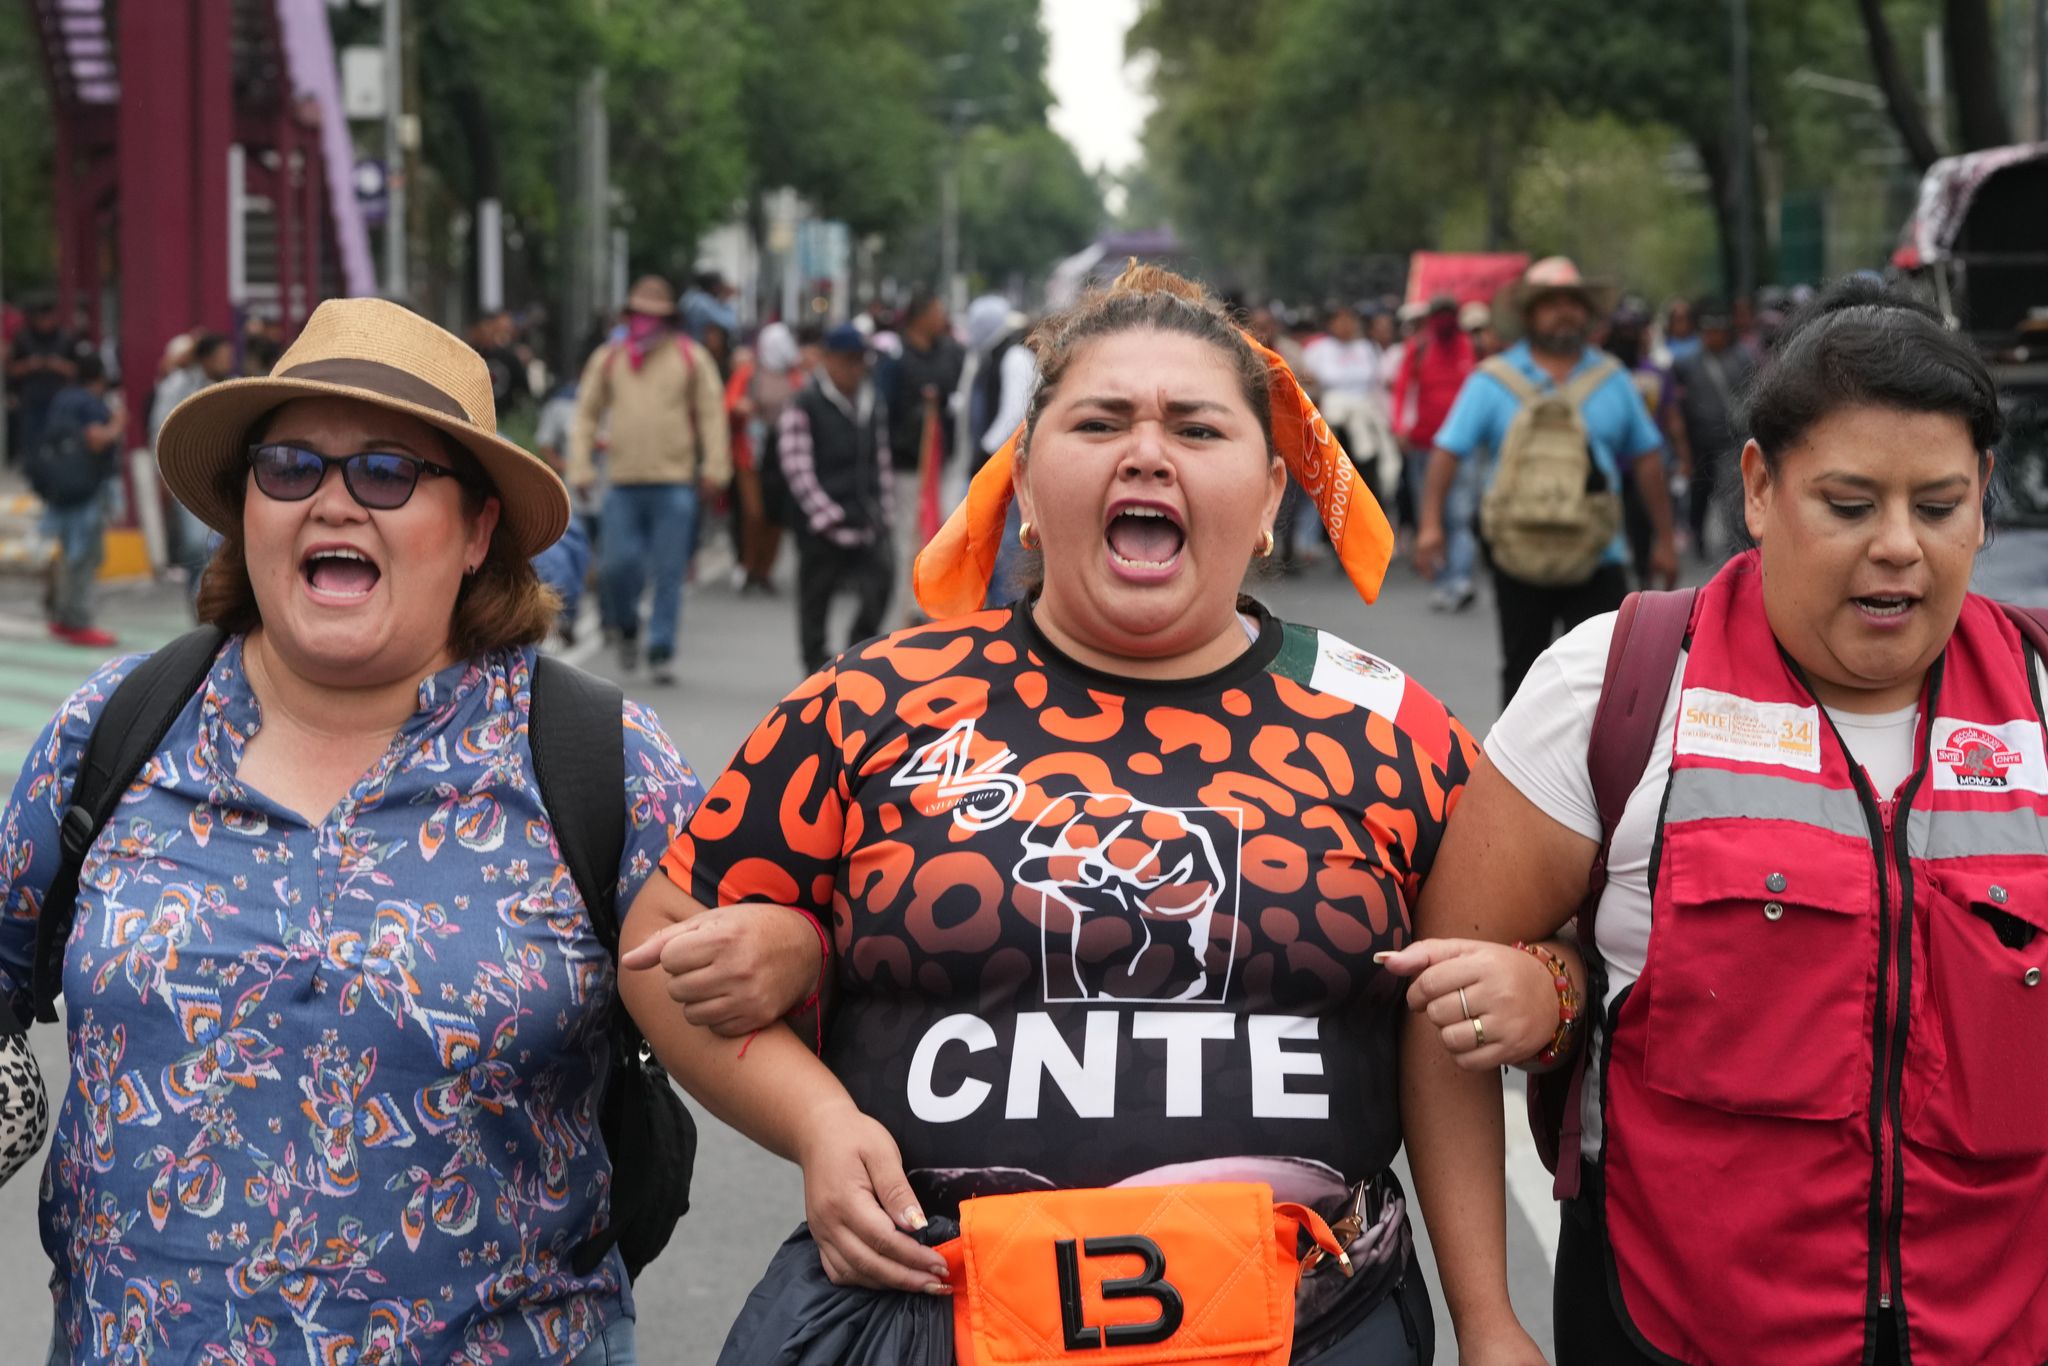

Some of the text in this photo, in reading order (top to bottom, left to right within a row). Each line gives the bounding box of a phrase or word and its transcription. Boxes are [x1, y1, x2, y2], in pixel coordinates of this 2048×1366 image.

[1687, 708, 1727, 728] SNTE
[1781, 720, 1810, 742] 34
[907, 1010, 1330, 1123] CNTE
